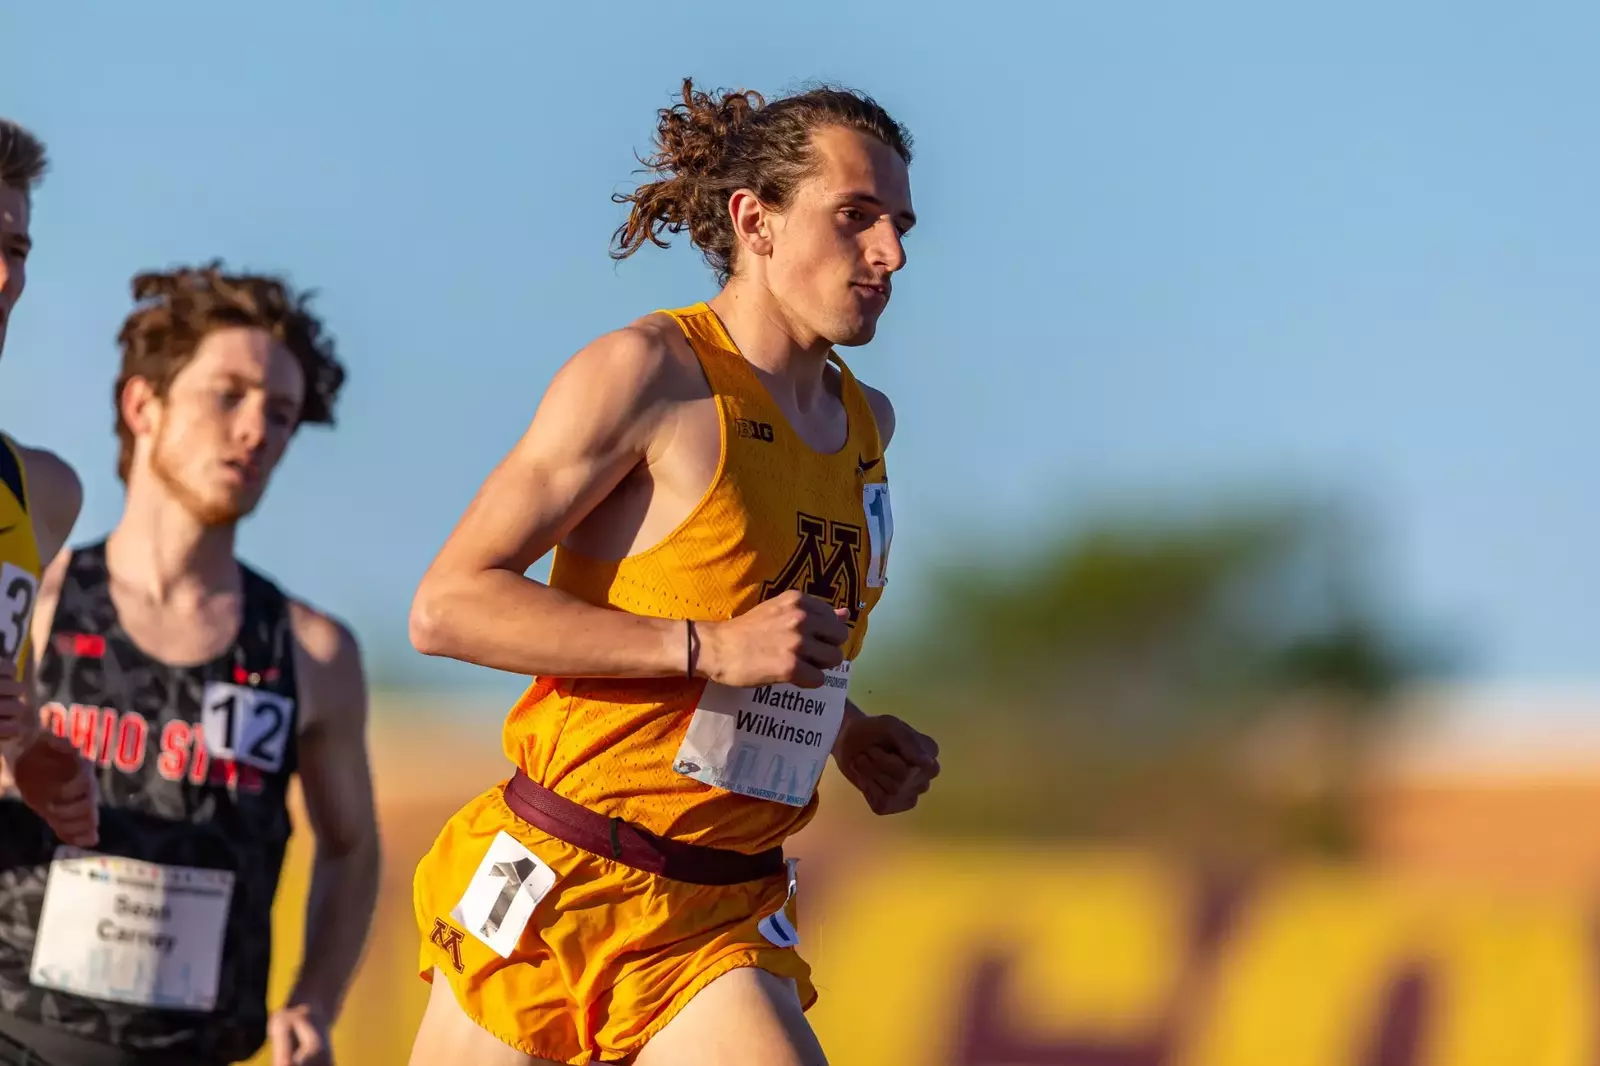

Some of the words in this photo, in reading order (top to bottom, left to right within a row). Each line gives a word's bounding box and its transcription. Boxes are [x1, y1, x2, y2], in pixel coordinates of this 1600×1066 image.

[752, 685, 826, 717] Matthew
[211, 695, 285, 762] 12
[737, 709, 823, 747] Wilkinson
[429, 916, 466, 974] M
